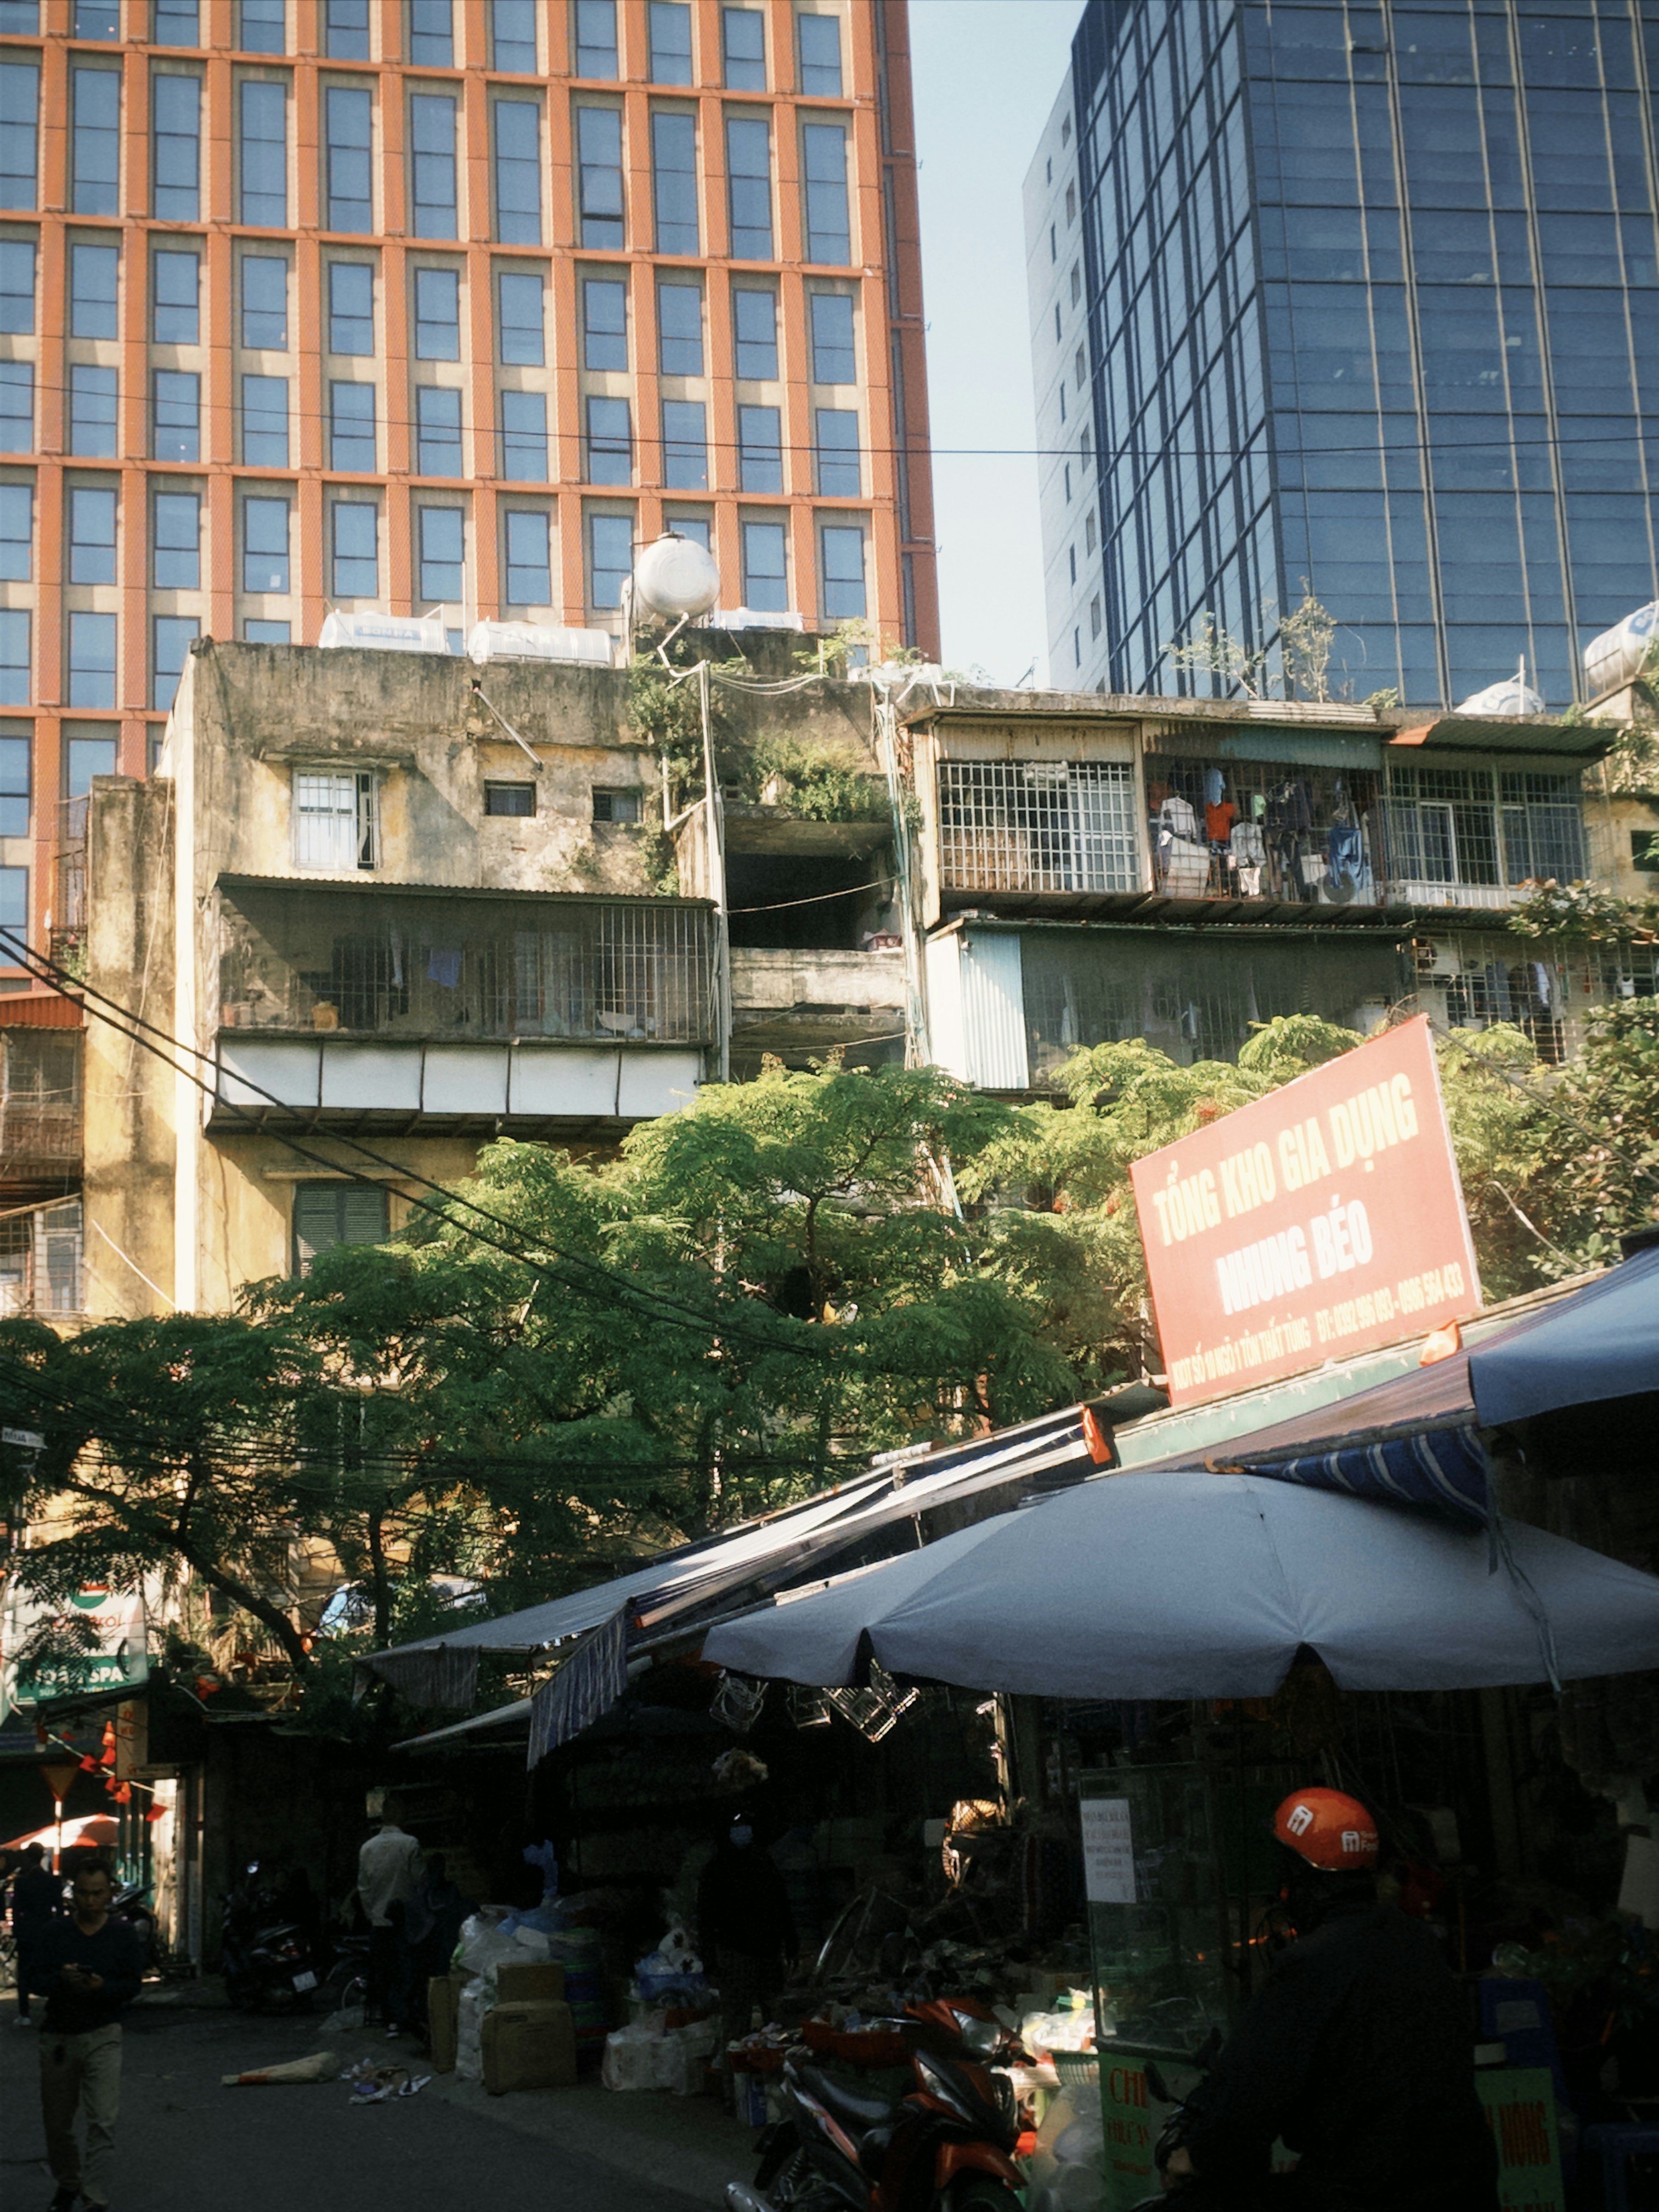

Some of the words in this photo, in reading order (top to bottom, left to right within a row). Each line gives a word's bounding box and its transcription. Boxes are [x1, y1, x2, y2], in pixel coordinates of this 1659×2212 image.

[1153, 1160, 1221, 1246] TỔNG
[1218, 1141, 1276, 1218] KHO
[1278, 1117, 1331, 1192] GIA
[1329, 1073, 1419, 1173] DỤNG
[1216, 1225, 1312, 1316] NHUNG
[1311, 1193, 1373, 1279] BÉO
[1191, 1341, 1206, 1384] SỐ
[1214, 1336, 1235, 1377] NGÕ
[1234, 1341, 1242, 1370] 1
[1239, 1329, 1262, 1368] TÔN
[1259, 1316, 1285, 1362] THẤT
[1282, 1313, 1312, 1354] TÙNG
[1443, 1261, 1465, 1299] 433
[88, 1666, 125, 1684] SPA
